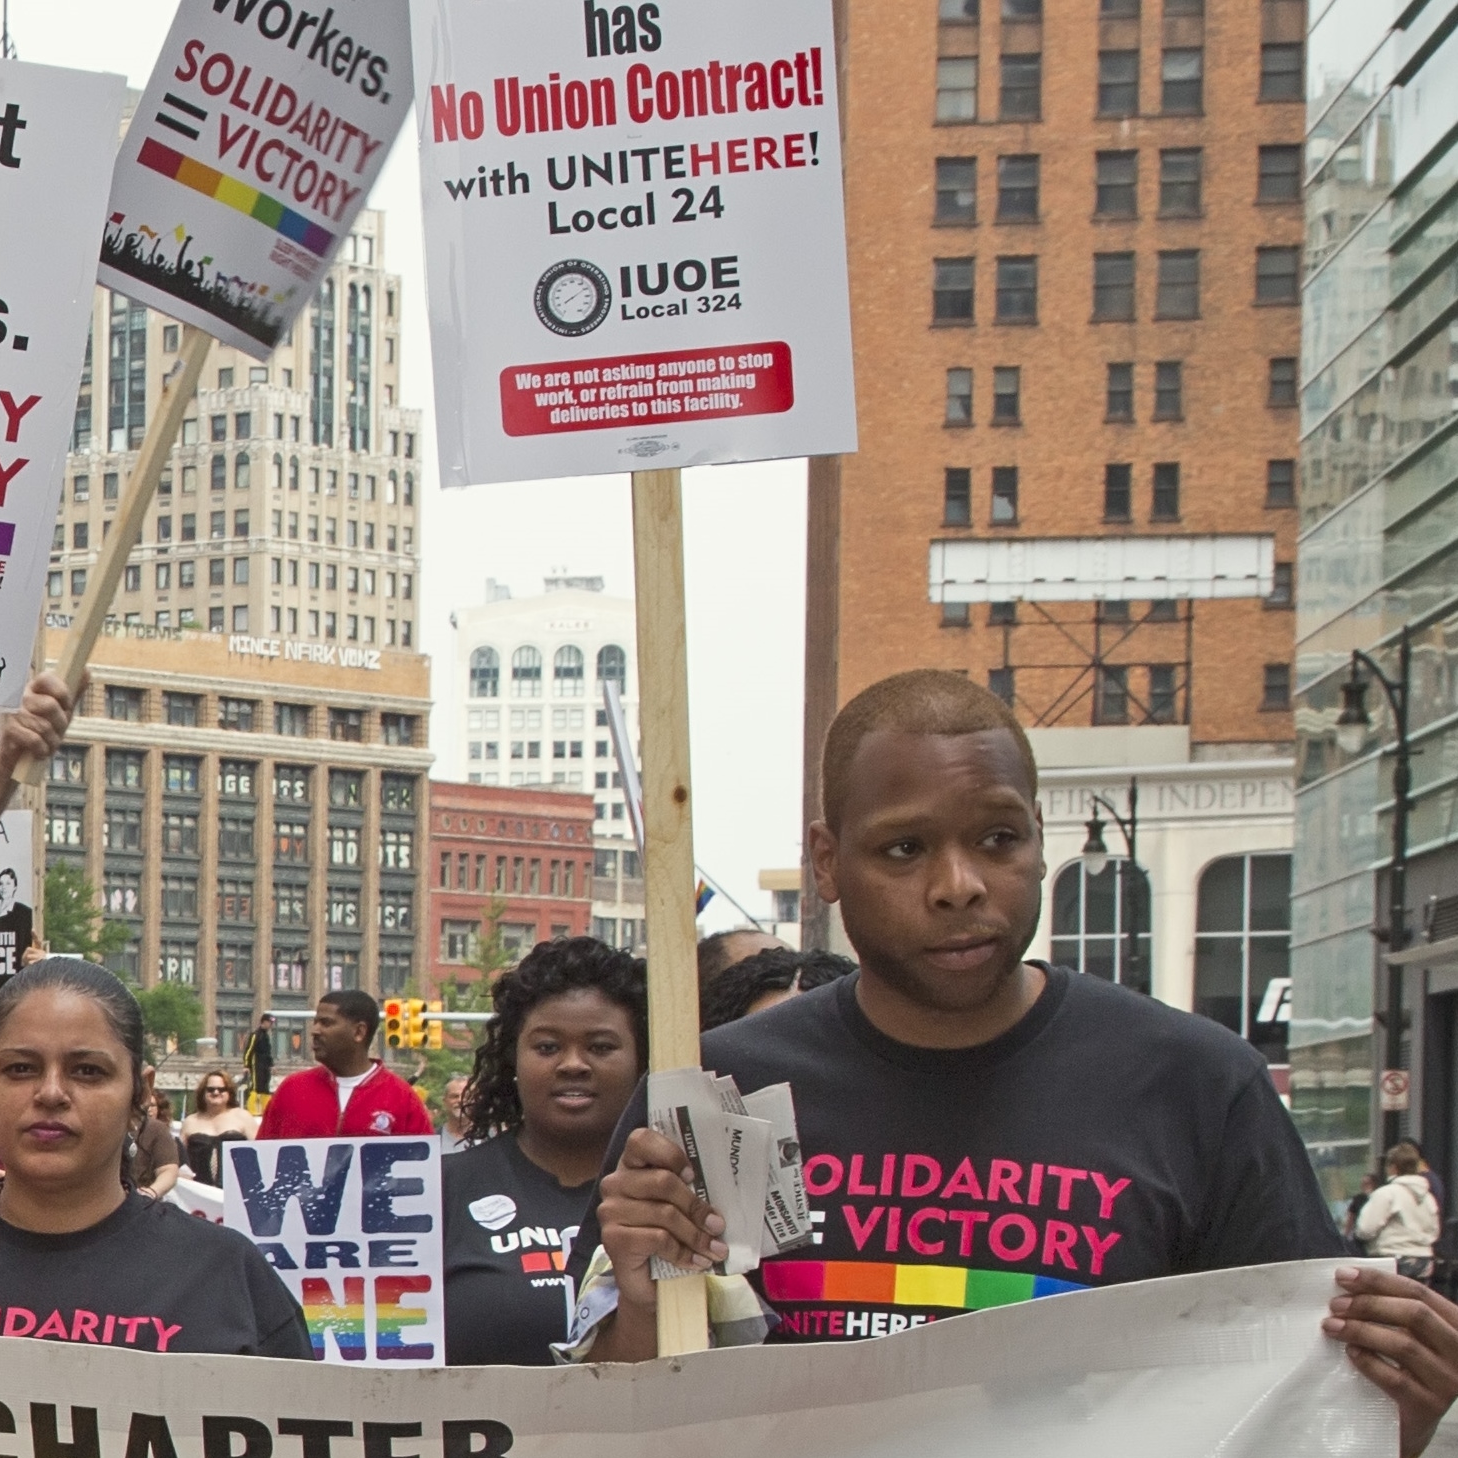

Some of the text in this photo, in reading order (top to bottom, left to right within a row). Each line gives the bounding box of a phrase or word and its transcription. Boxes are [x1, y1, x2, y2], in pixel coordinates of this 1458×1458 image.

[583, 2, 662, 58] has
[174, 38, 383, 174] SOLIDARITY
[431, 47, 824, 144] No Union Contract!
[219, 113, 362, 223] VICTORY
[443, 131, 819, 201] with UNITEHERE!
[547, 186, 725, 235] Local 24
[619, 256, 739, 298] IUOE
[621, 294, 741, 320] Local 324
[515, 352, 773, 390] We are not asking anyone to stop
[535, 373, 756, 407] work, or refrain from making
[550, 394, 743, 424] deliveries to this facility.
[229, 635, 281, 658] MINCE
[1049, 786, 1135, 814] FIRS
[229, 1142, 432, 1237] WE
[804, 1154, 1131, 1219] OLIDARITY
[771, 1190, 799, 1234] MONSANTO
[775, 1221, 785, 1238] fire
[257, 1240, 418, 1270] ARE
[842, 1206, 1121, 1275] VICTORY
[302, 1274, 434, 1362] NE
